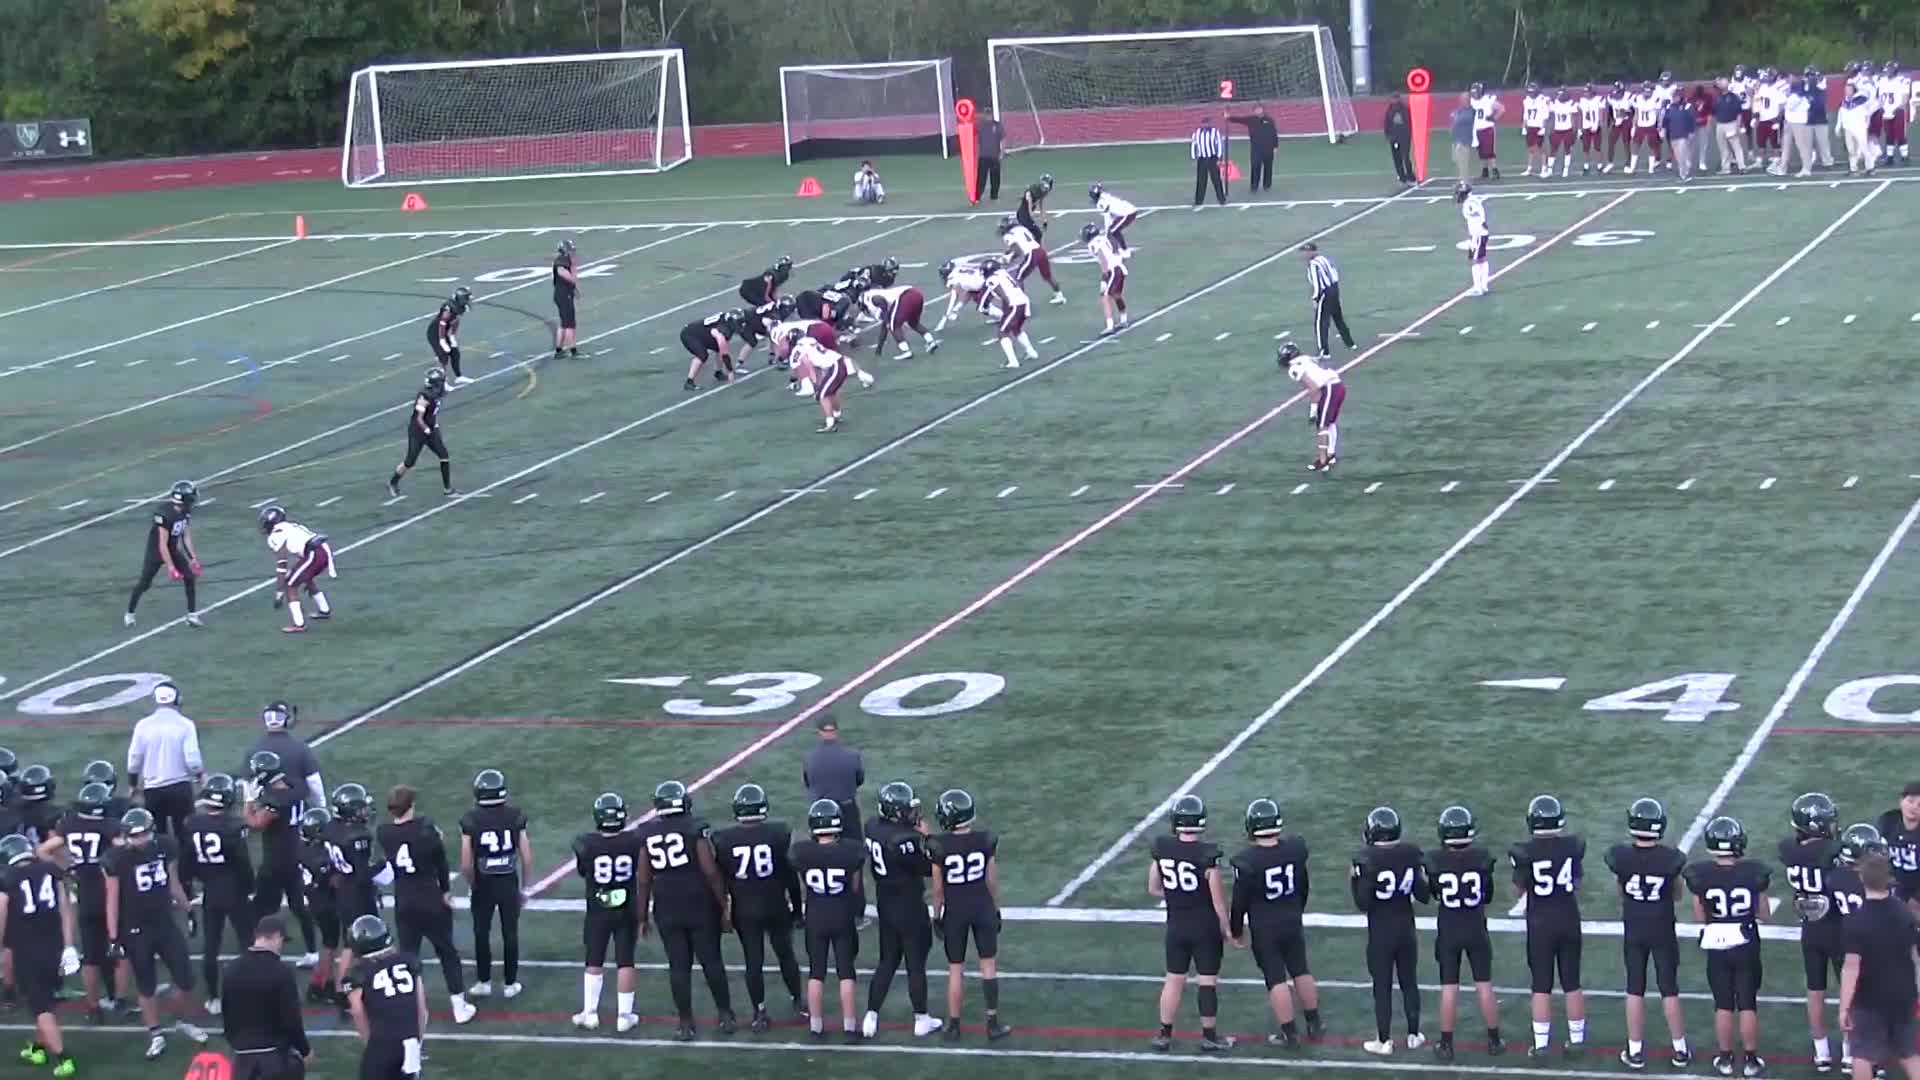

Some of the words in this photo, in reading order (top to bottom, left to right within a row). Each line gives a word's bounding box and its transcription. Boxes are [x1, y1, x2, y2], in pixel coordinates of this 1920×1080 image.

[1220, 81, 1233, 99] 2
[66, 832, 101, 864] 57
[192, 831, 225, 864] 12
[480, 829, 513, 852] 41
[646, 832, 689, 870] 52
[395, 843, 416, 874] 4
[593, 854, 633, 884] 89
[732, 844, 774, 879] 78
[944, 851, 986, 884] 22
[1159, 858, 1199, 892] 56
[135, 859, 168, 892] 64
[805, 868, 846, 895] 95
[1264, 863, 1295, 900] 51
[1375, 867, 1415, 900] 34
[1438, 871, 1482, 908] 23
[1532, 857, 1574, 896] 54
[1625, 873, 1665, 901] 47
[19, 873, 57, 914] 14
[1705, 887, 1751, 918] 32
[373, 963, 415, 998] 45
